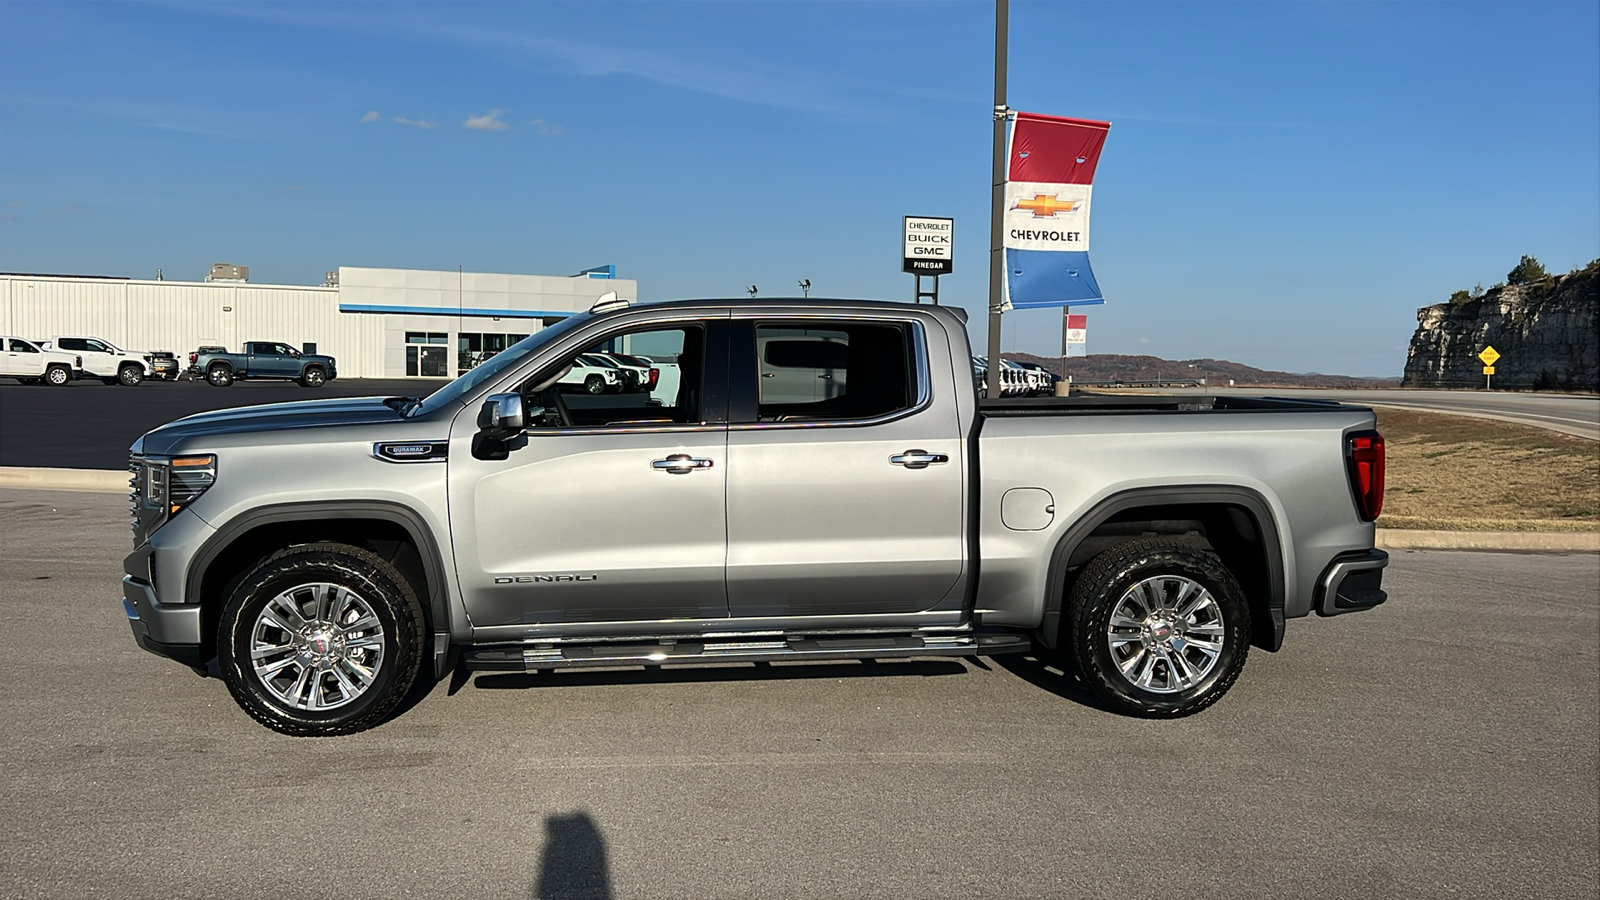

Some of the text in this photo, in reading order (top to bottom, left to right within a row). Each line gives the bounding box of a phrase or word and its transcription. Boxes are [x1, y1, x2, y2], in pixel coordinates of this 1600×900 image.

[909, 222, 949, 230] CHEVROLET
[908, 234, 949, 243] BUICK
[1010, 229, 1080, 242] CHEVROLET
[914, 247, 944, 255] GMC
[913, 261, 944, 269] PINEGAR
[494, 574, 597, 584] DENALI
